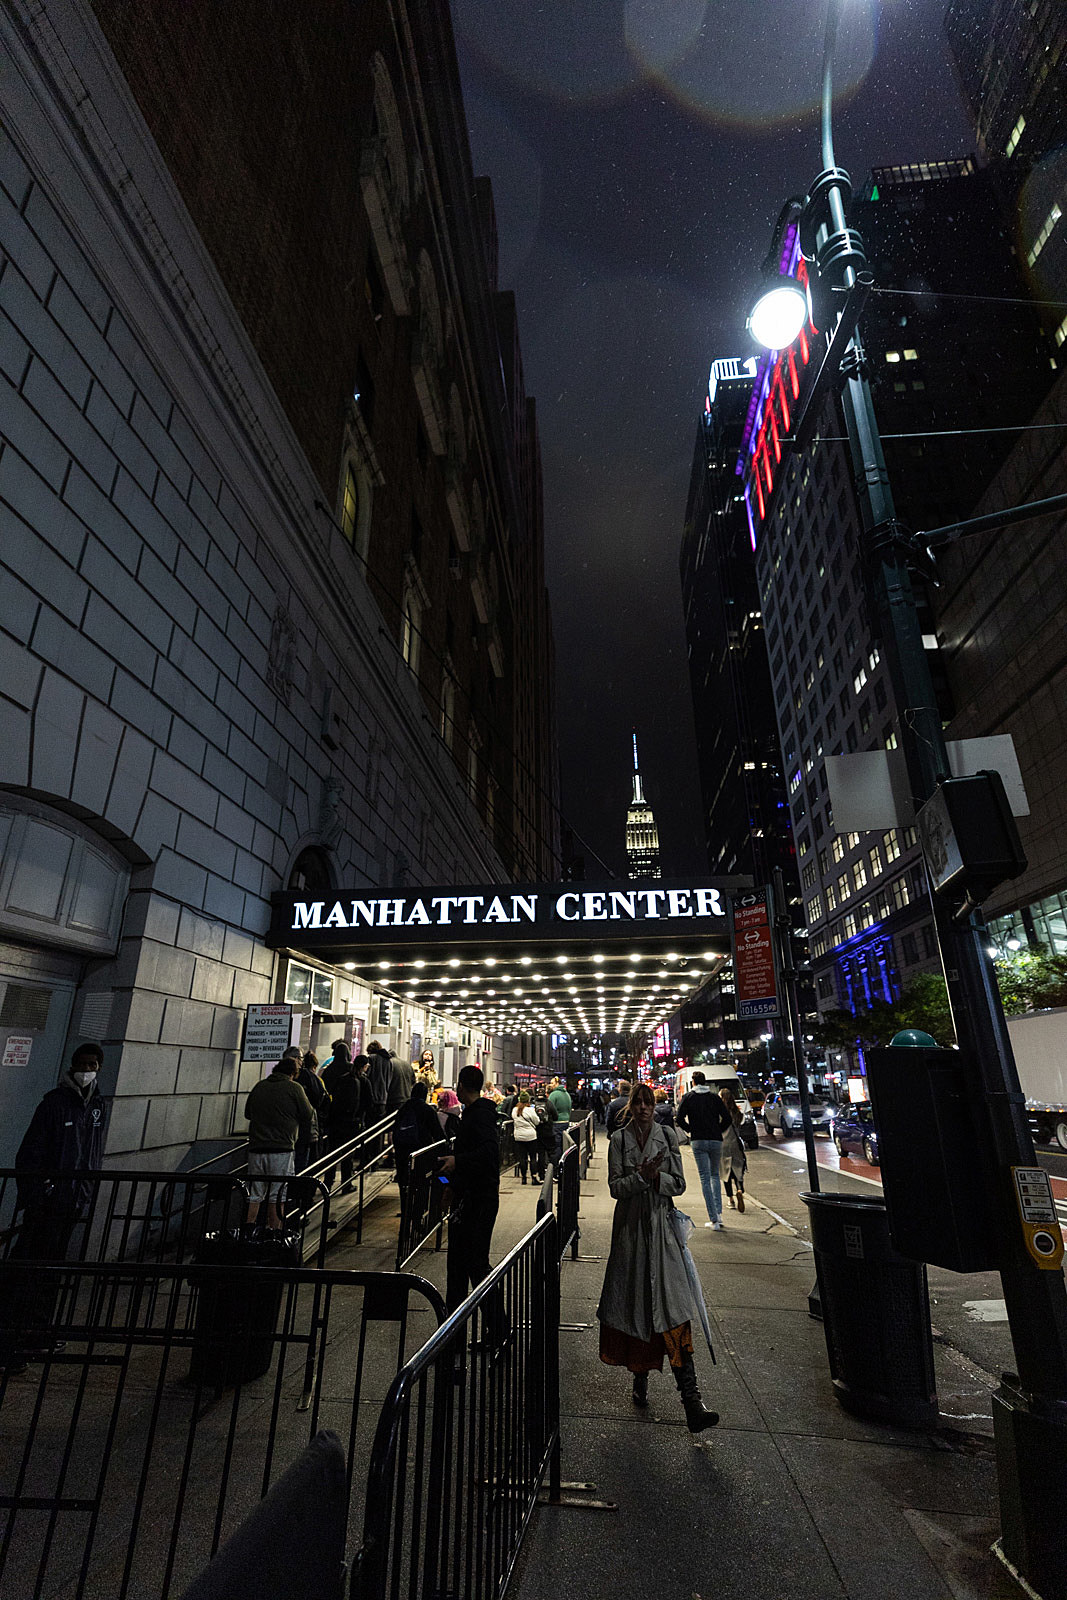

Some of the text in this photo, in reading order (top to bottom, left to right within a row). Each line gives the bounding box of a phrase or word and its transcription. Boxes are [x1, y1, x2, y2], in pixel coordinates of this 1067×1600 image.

[291, 888, 726, 929] MANHATTAN CENTER
[742, 906, 766, 917] Standing
[745, 940, 769, 950] Standing
[742, 1004, 768, 1015] 101655
